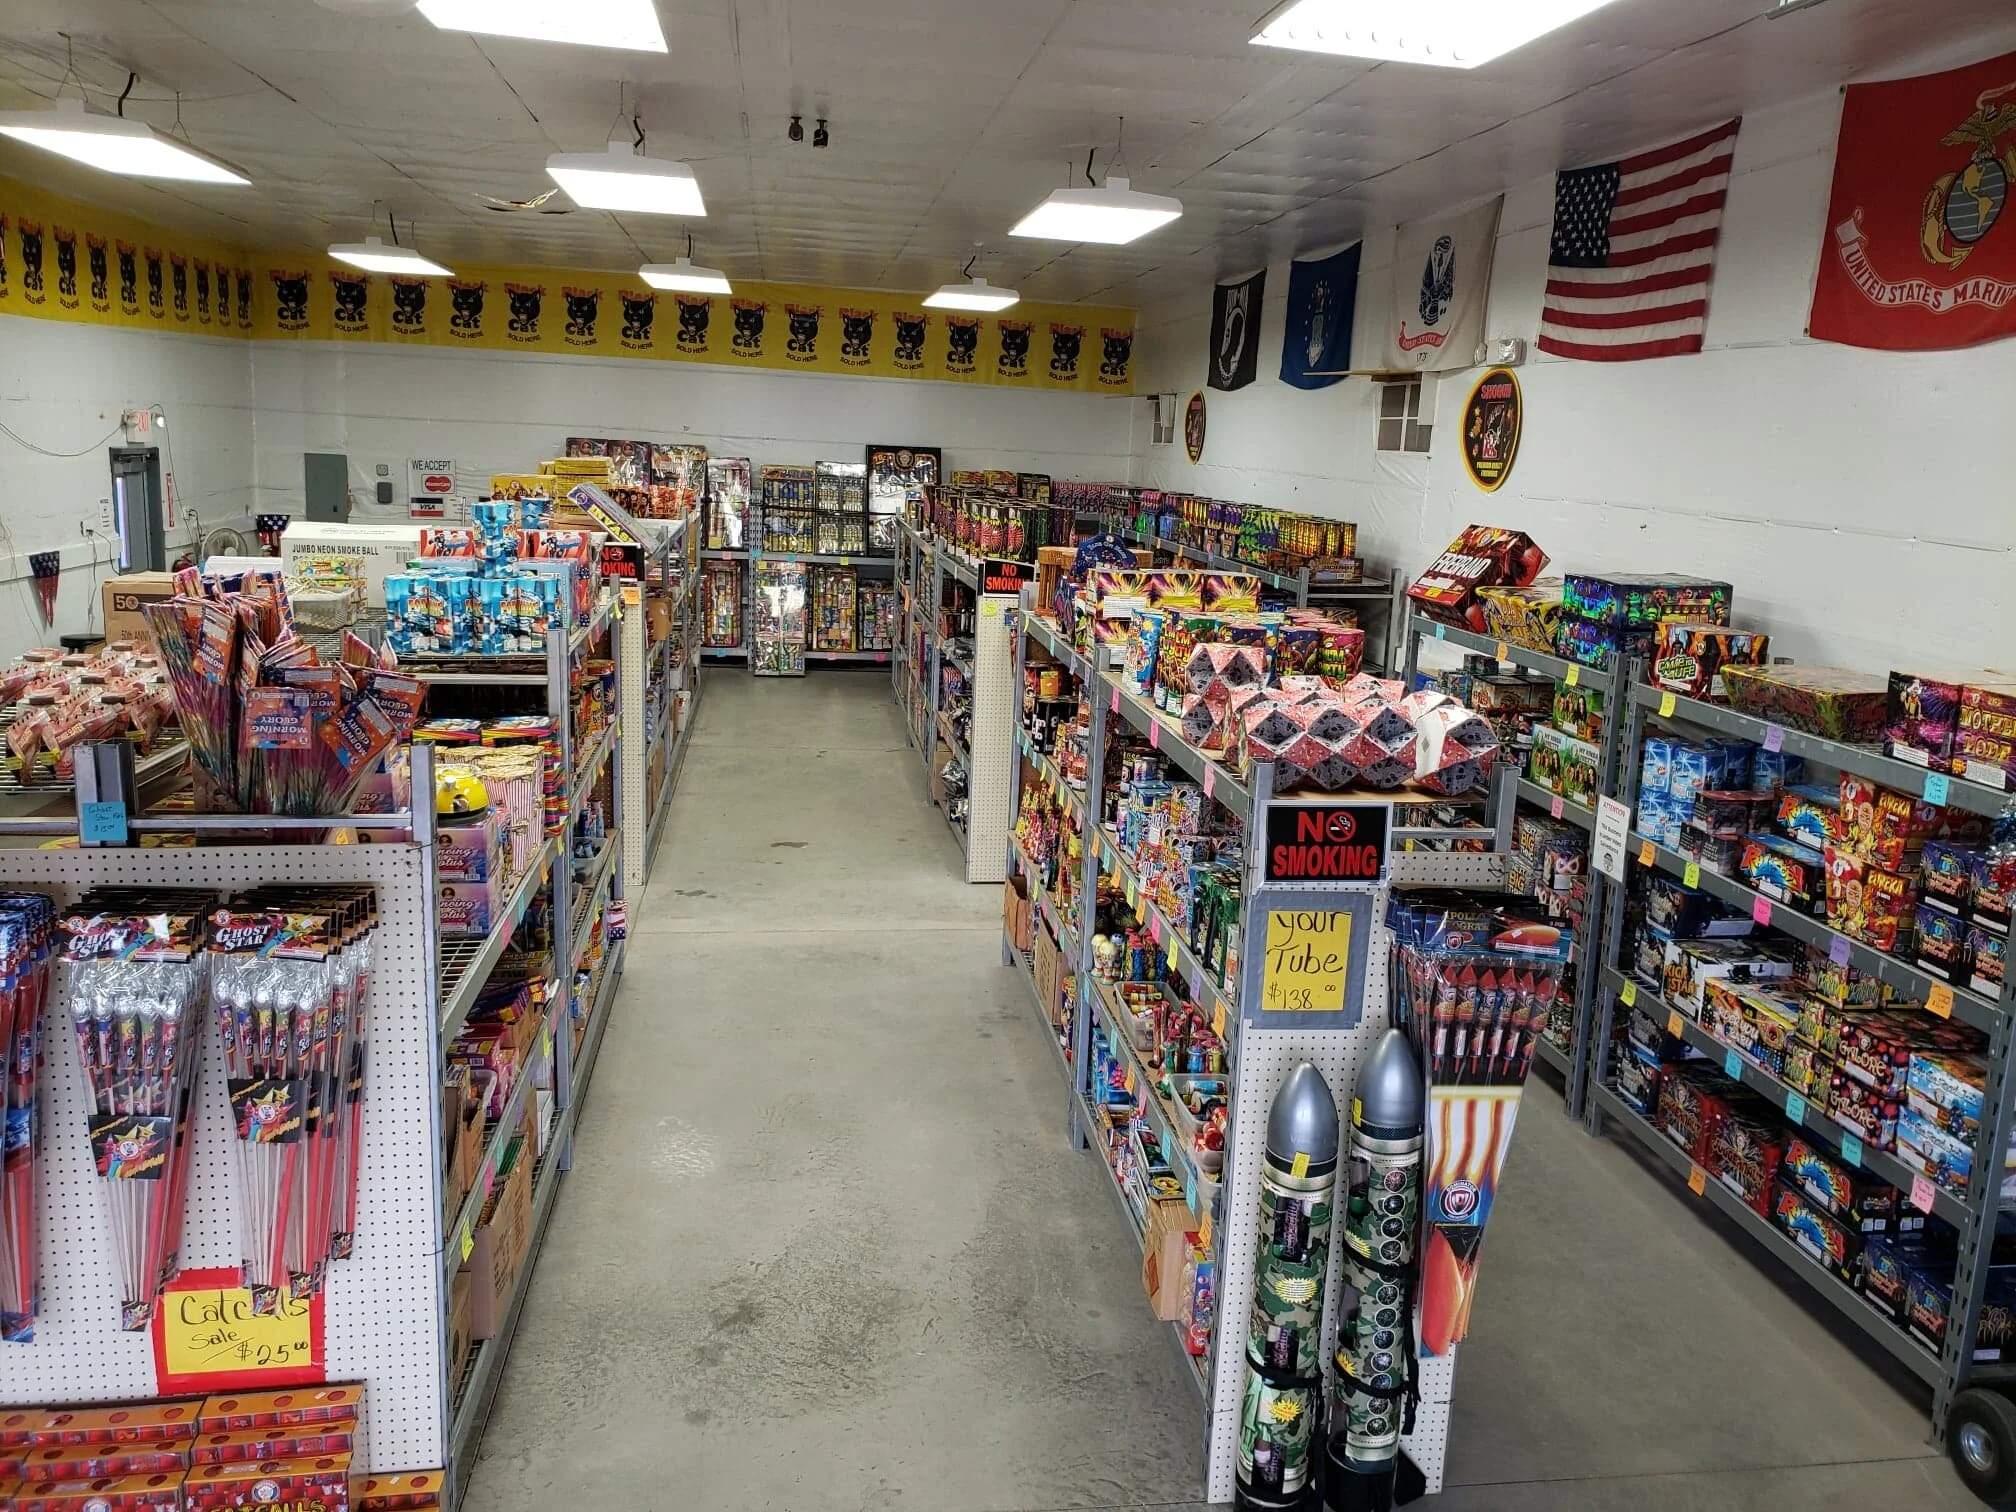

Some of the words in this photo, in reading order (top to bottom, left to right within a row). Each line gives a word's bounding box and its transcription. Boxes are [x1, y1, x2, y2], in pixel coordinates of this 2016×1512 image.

[1845, 251, 1886, 302] UNITED
[1888, 279, 1942, 309] STATES
[1953, 278, 2016, 307] MARIN
[278, 306, 306, 320] Cat
[334, 308, 364, 322] Cat
[393, 310, 423, 324] Cat
[451, 314, 480, 328] Cat
[508, 319, 538, 332] Cat
[565, 322, 594, 336] Cat
[622, 326, 650, 339] Cat
[677, 330, 706, 344] Cat
[733, 335, 760, 348] Cat
[787, 338, 815, 352] Cat
[841, 343, 869, 356] Cat
[894, 346, 922, 360] Cat
[947, 351, 974, 364] Cat
[999, 355, 1026, 368] Cat
[1051, 358, 1077, 371] Cat
[1100, 363, 1126, 376] Cat
[412, 460, 424, 470] WE
[425, 460, 451, 470] ACCEPT
[292, 544, 316, 553] JUMBO
[317, 545, 335, 554] NEON
[337, 545, 360, 555] SMOKE
[362, 546, 379, 555] BALL
[599, 562, 636, 576] OKING
[1002, 564, 1017, 576] NO
[985, 577, 1024, 591] SMOKIN
[1674, 665, 1696, 678] LIFE
[260, 716, 298, 724] GLORY
[1960, 705, 2016, 739] MOTHE
[251, 725, 308, 733] MORNING
[346, 718, 371, 746] GLORY
[335, 718, 368, 756] MORNING
[1879, 792, 1912, 817] EUREKA
[1297, 811, 1356, 842] NO
[1521, 831, 1535, 854] BIG
[439, 846, 472, 858] ncing
[439, 859, 464, 867] otus
[1273, 845, 1378, 876] SMOKING
[1509, 868, 1526, 892] BIG
[1868, 869, 1904, 896] EUREKA
[440, 899, 474, 910] ncing
[441, 910, 466, 919] otus
[1274, 911, 1352, 948] your
[1451, 921, 1490, 931] OGRAM
[216, 924, 272, 945] GHOST
[79, 940, 122, 958] STA
[224, 935, 264, 951] STAR
[1266, 943, 1344, 974] Tube
[1839, 1040, 1886, 1077] GALORE
[1830, 1090, 1876, 1129] GALORE
[180, 1289, 309, 1326] Catcls
[234, 1340, 290, 1366] $25
